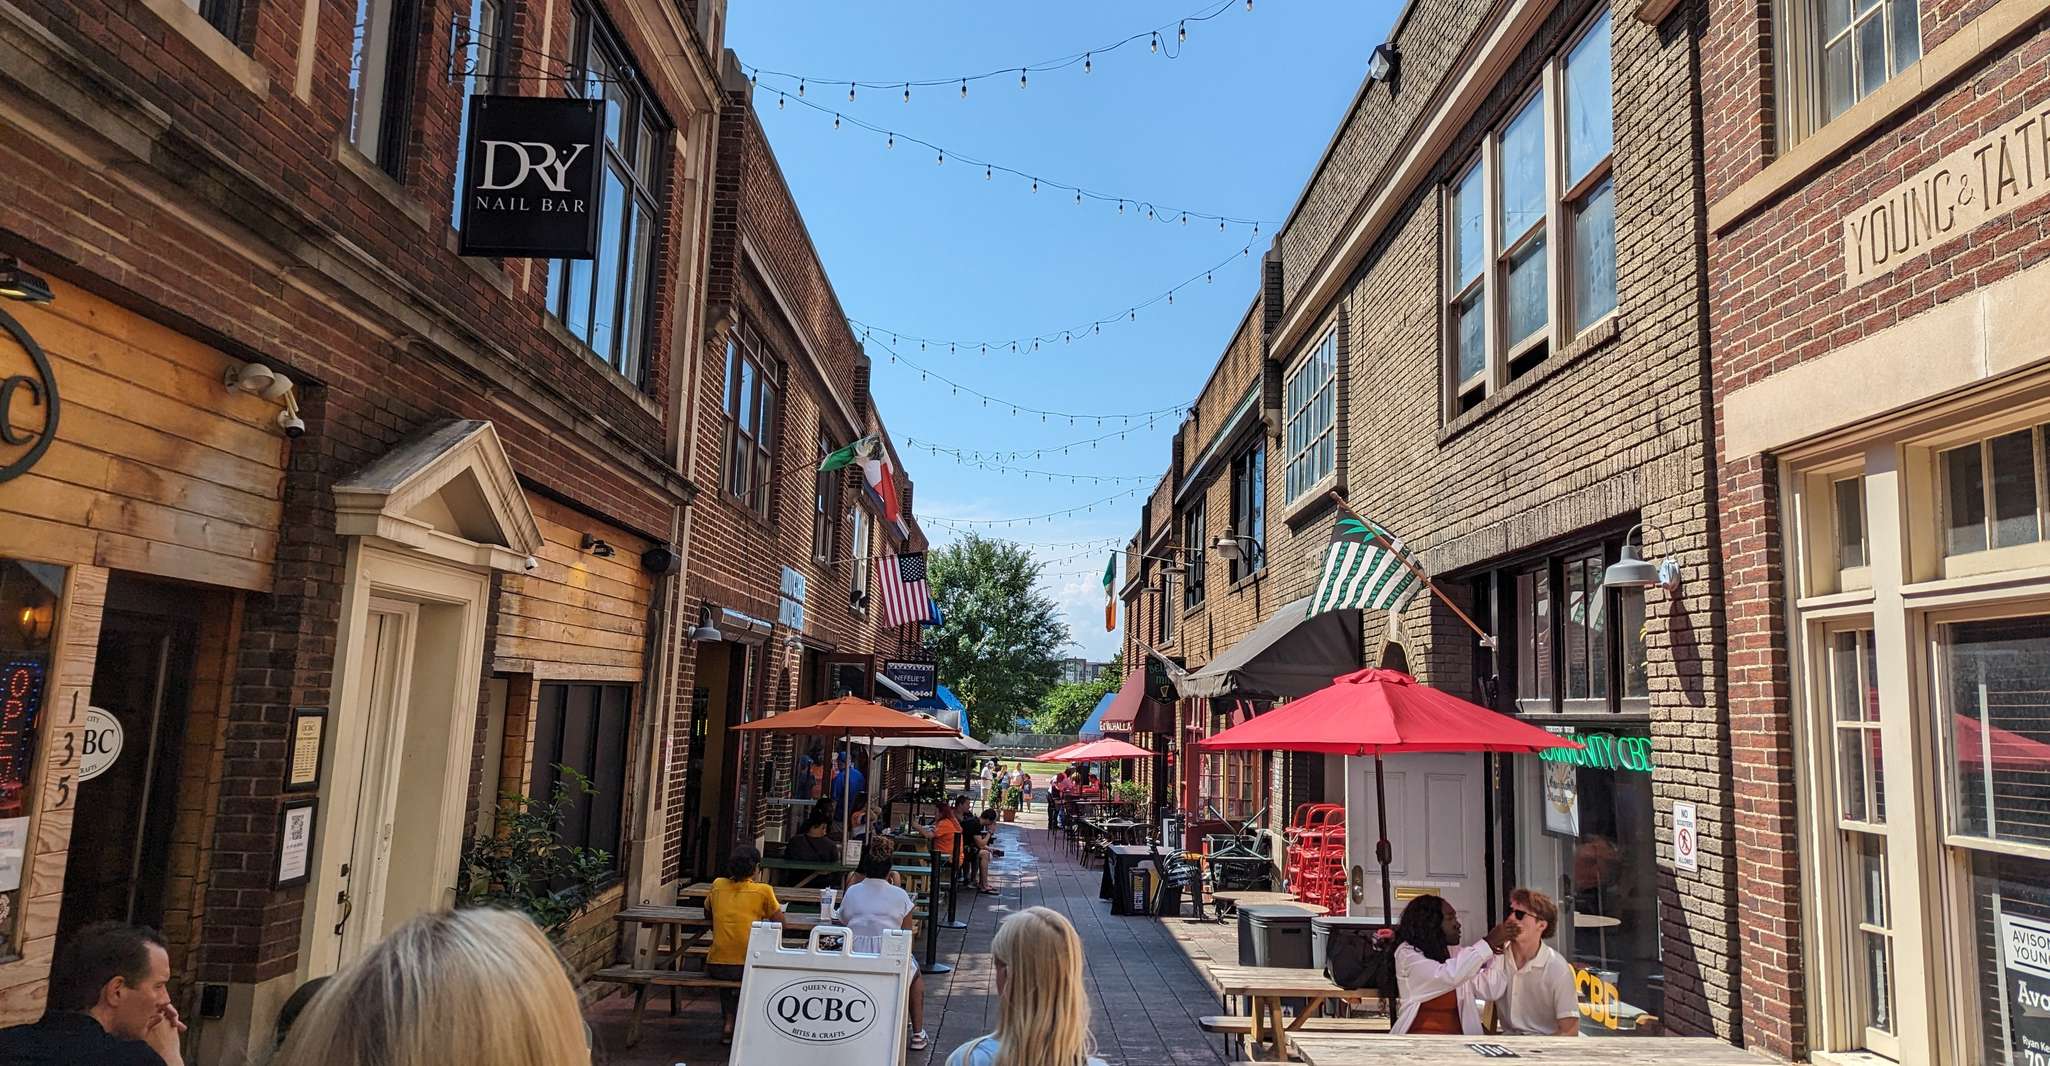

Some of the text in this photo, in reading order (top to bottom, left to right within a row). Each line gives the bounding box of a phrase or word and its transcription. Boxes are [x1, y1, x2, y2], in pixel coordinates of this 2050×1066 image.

[476, 140, 591, 192] DRY
[476, 196, 585, 213] NAIL BAR
[1850, 169, 1955, 275] YOUNG
[1957, 174, 1976, 206] &
[1617, 737, 1653, 772] CBD
[2014, 945, 2050, 966] YOUN
[802, 984, 846, 993] QUEEN CITY
[777, 995, 867, 1023] QCBC
[792, 1027, 810, 1038] BITES
[819, 1030, 845, 1039] CRAFTS
